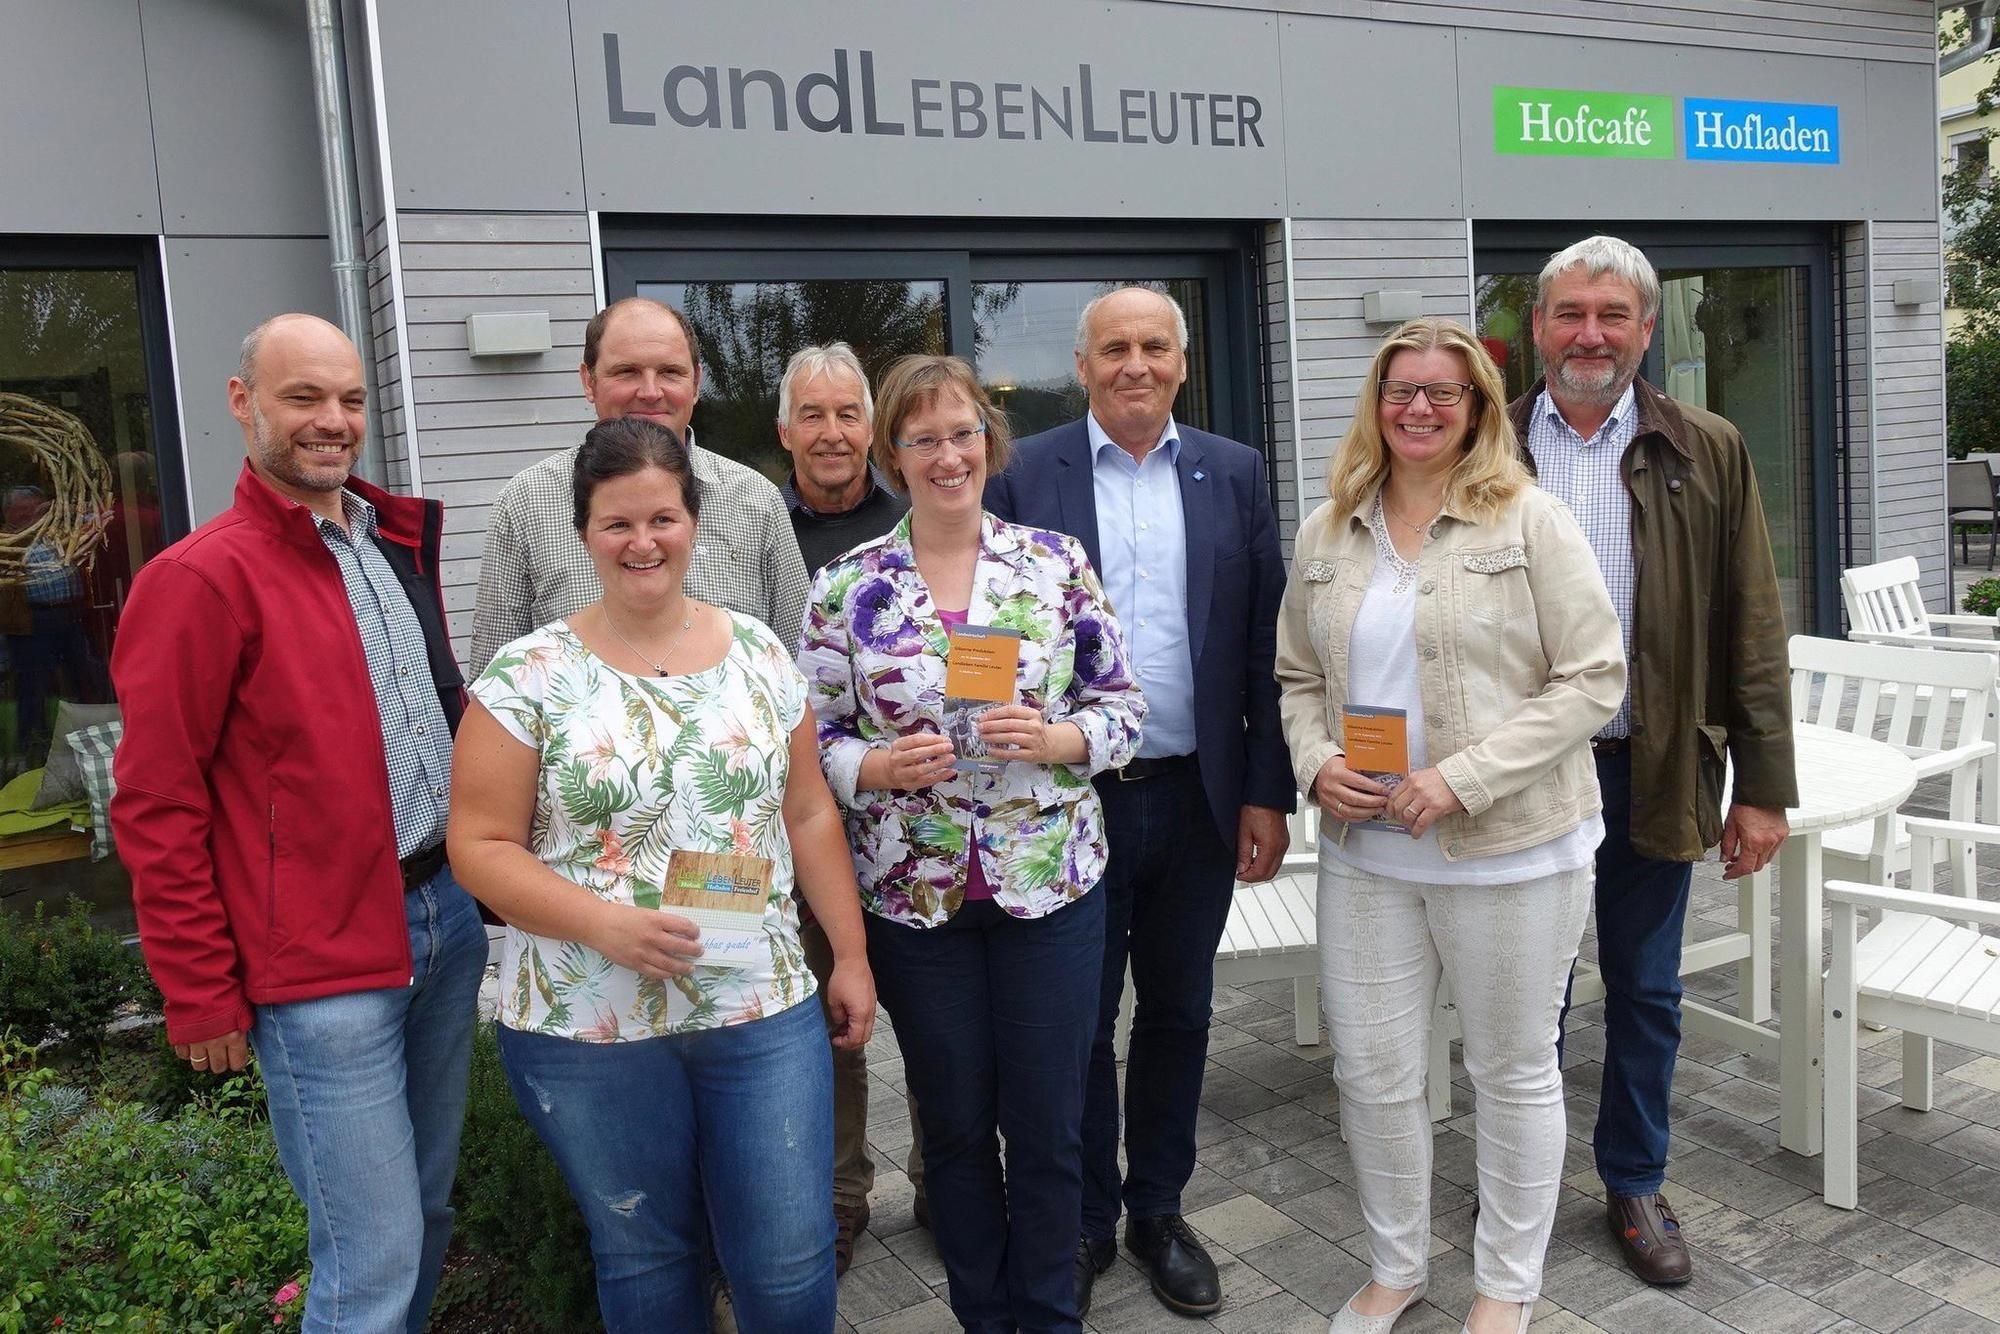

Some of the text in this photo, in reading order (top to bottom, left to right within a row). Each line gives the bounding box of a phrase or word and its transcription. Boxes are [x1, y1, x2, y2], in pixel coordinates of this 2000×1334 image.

[1517, 101, 1653, 146] Hofcafé
[1694, 111, 1832, 154] Hofladen
[734, 874, 761, 888] LEUTER
